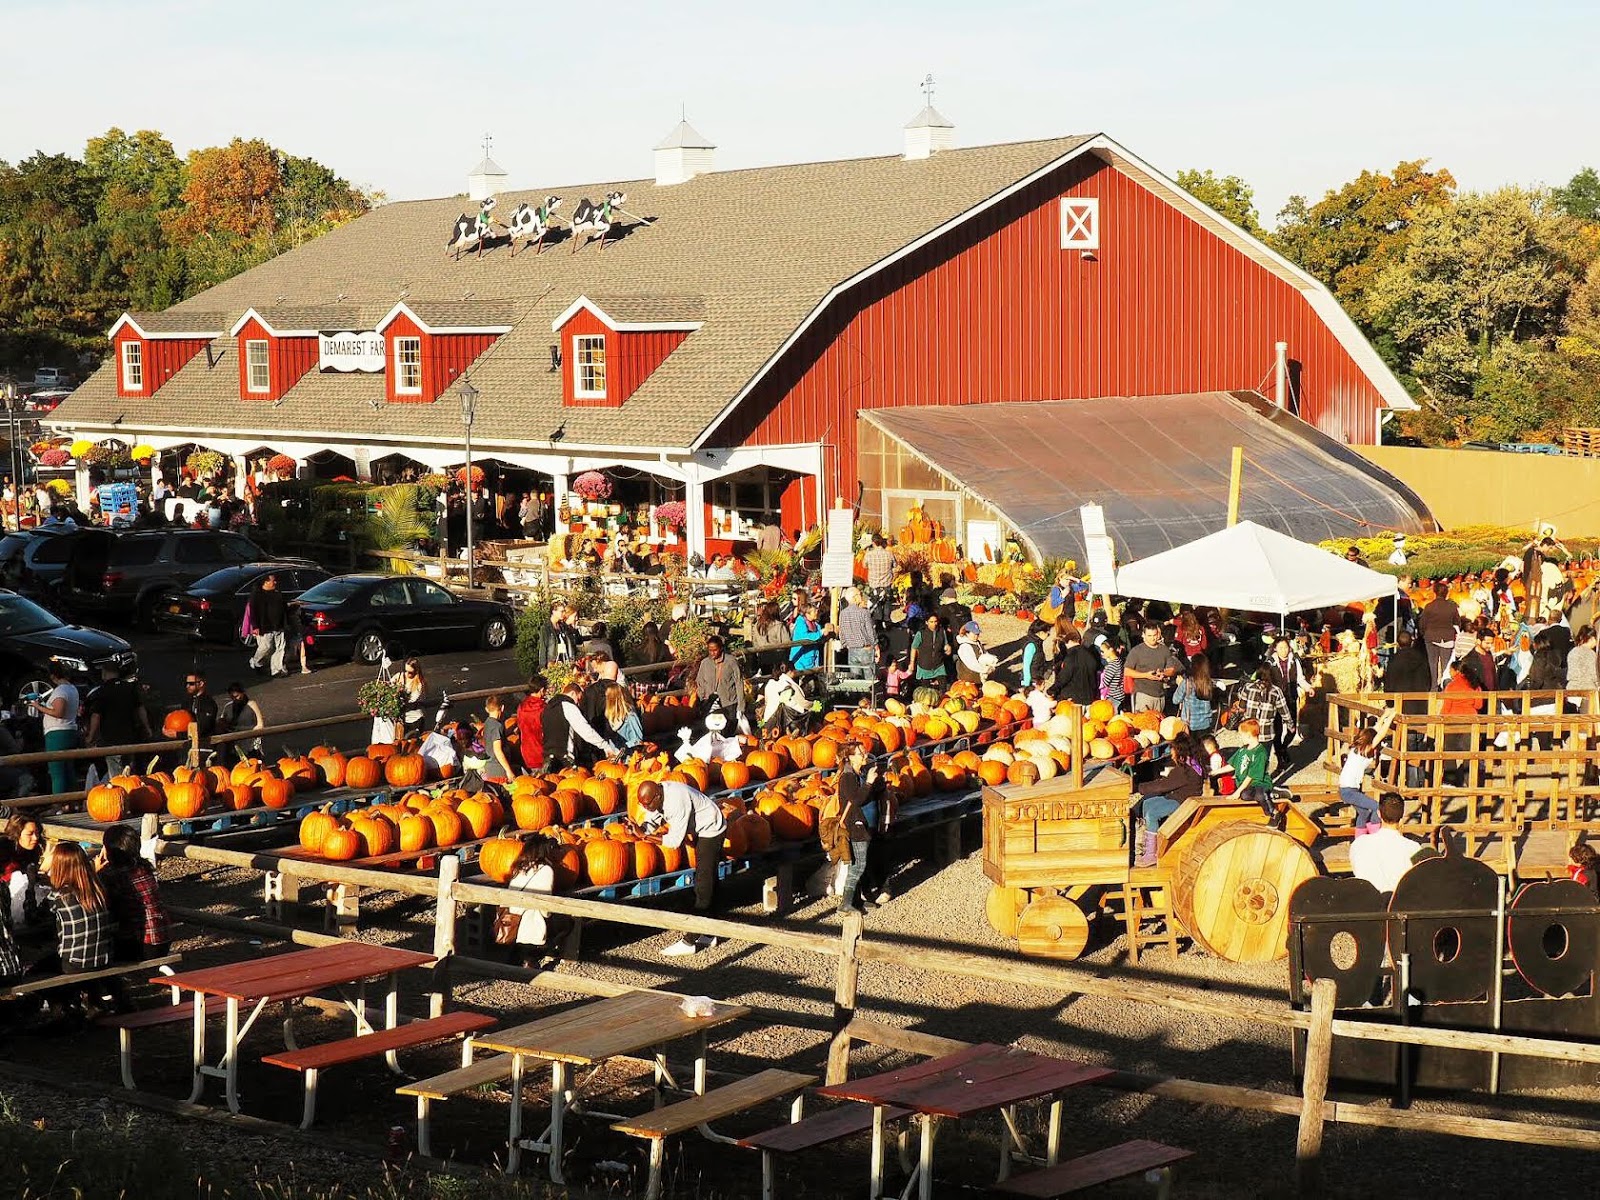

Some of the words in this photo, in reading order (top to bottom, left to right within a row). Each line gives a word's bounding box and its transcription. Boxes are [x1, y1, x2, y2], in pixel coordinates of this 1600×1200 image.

[324, 340, 366, 355] DEMAREST
[370, 340, 385, 355] FAR
[1012, 802, 1064, 821] JOHN
